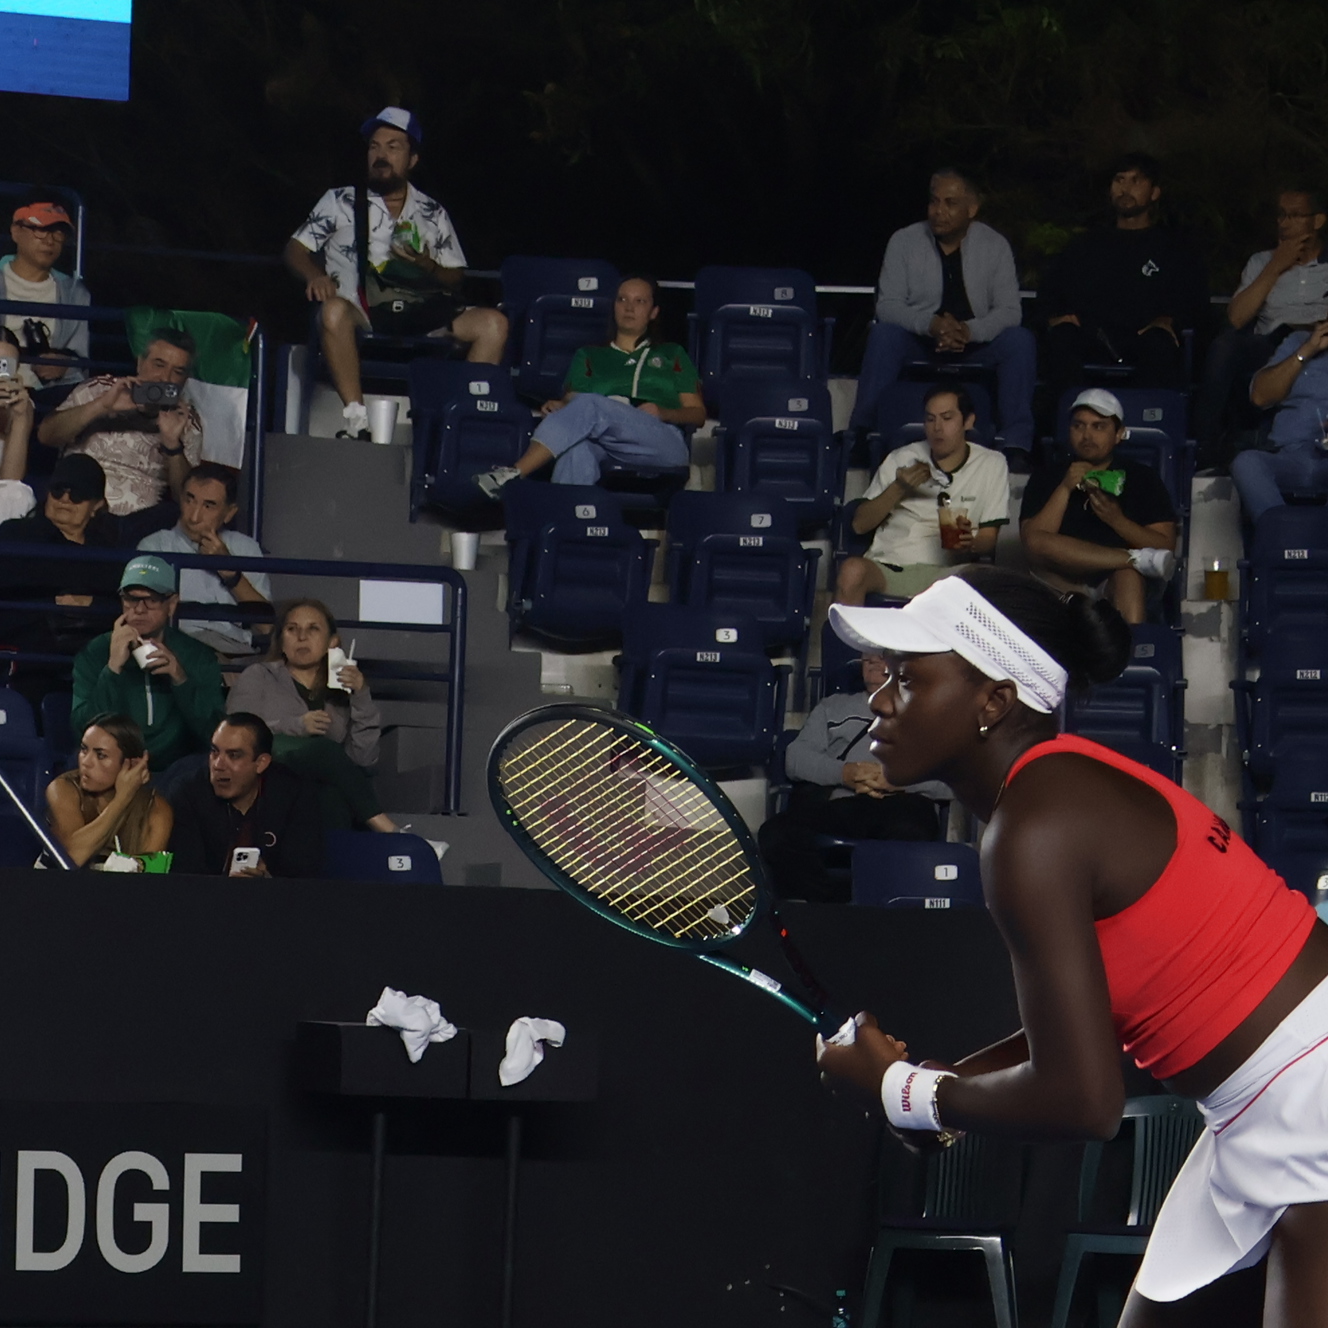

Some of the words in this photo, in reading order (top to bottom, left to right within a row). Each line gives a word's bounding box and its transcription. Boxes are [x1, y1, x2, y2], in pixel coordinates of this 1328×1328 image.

[1298, 670, 1319, 679] N212
[927, 898, 946, 908] N111
[901, 1072, 918, 1112] Wilson
